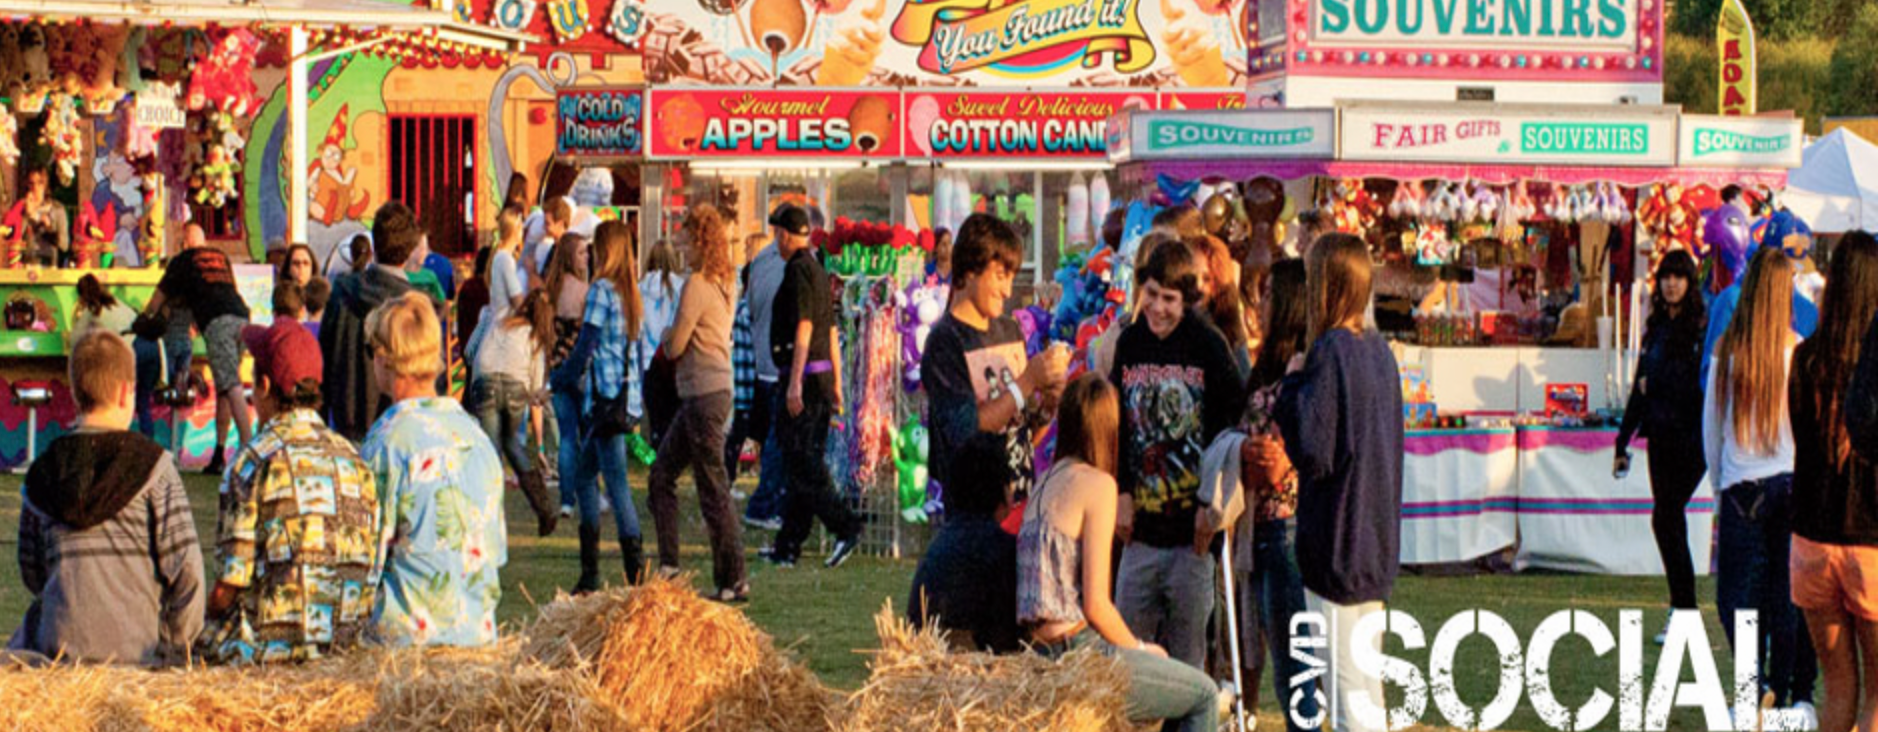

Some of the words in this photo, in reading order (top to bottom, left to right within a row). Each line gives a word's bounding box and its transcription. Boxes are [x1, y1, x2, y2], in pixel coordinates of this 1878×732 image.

[1320, 0, 1627, 38] SOUVENIRS
[935, 24, 997, 72] You
[1001, 0, 1095, 49] Found
[577, 97, 624, 121] COLD
[720, 92, 831, 115] Gourmet
[946, 94, 1011, 116] Sweet
[1016, 94, 1114, 116] Delicious
[563, 115, 636, 149] DRINKS
[700, 117, 853, 150] APPLES
[930, 118, 1038, 151] COTTON
[1158, 124, 1312, 146] SOUVENIRS
[1372, 123, 1448, 148] FAIR
[1455, 120, 1501, 140] GIFTS
[1524, 126, 1645, 151] SOUVENIRS
[1697, 131, 1789, 151] SOUVENIRS
